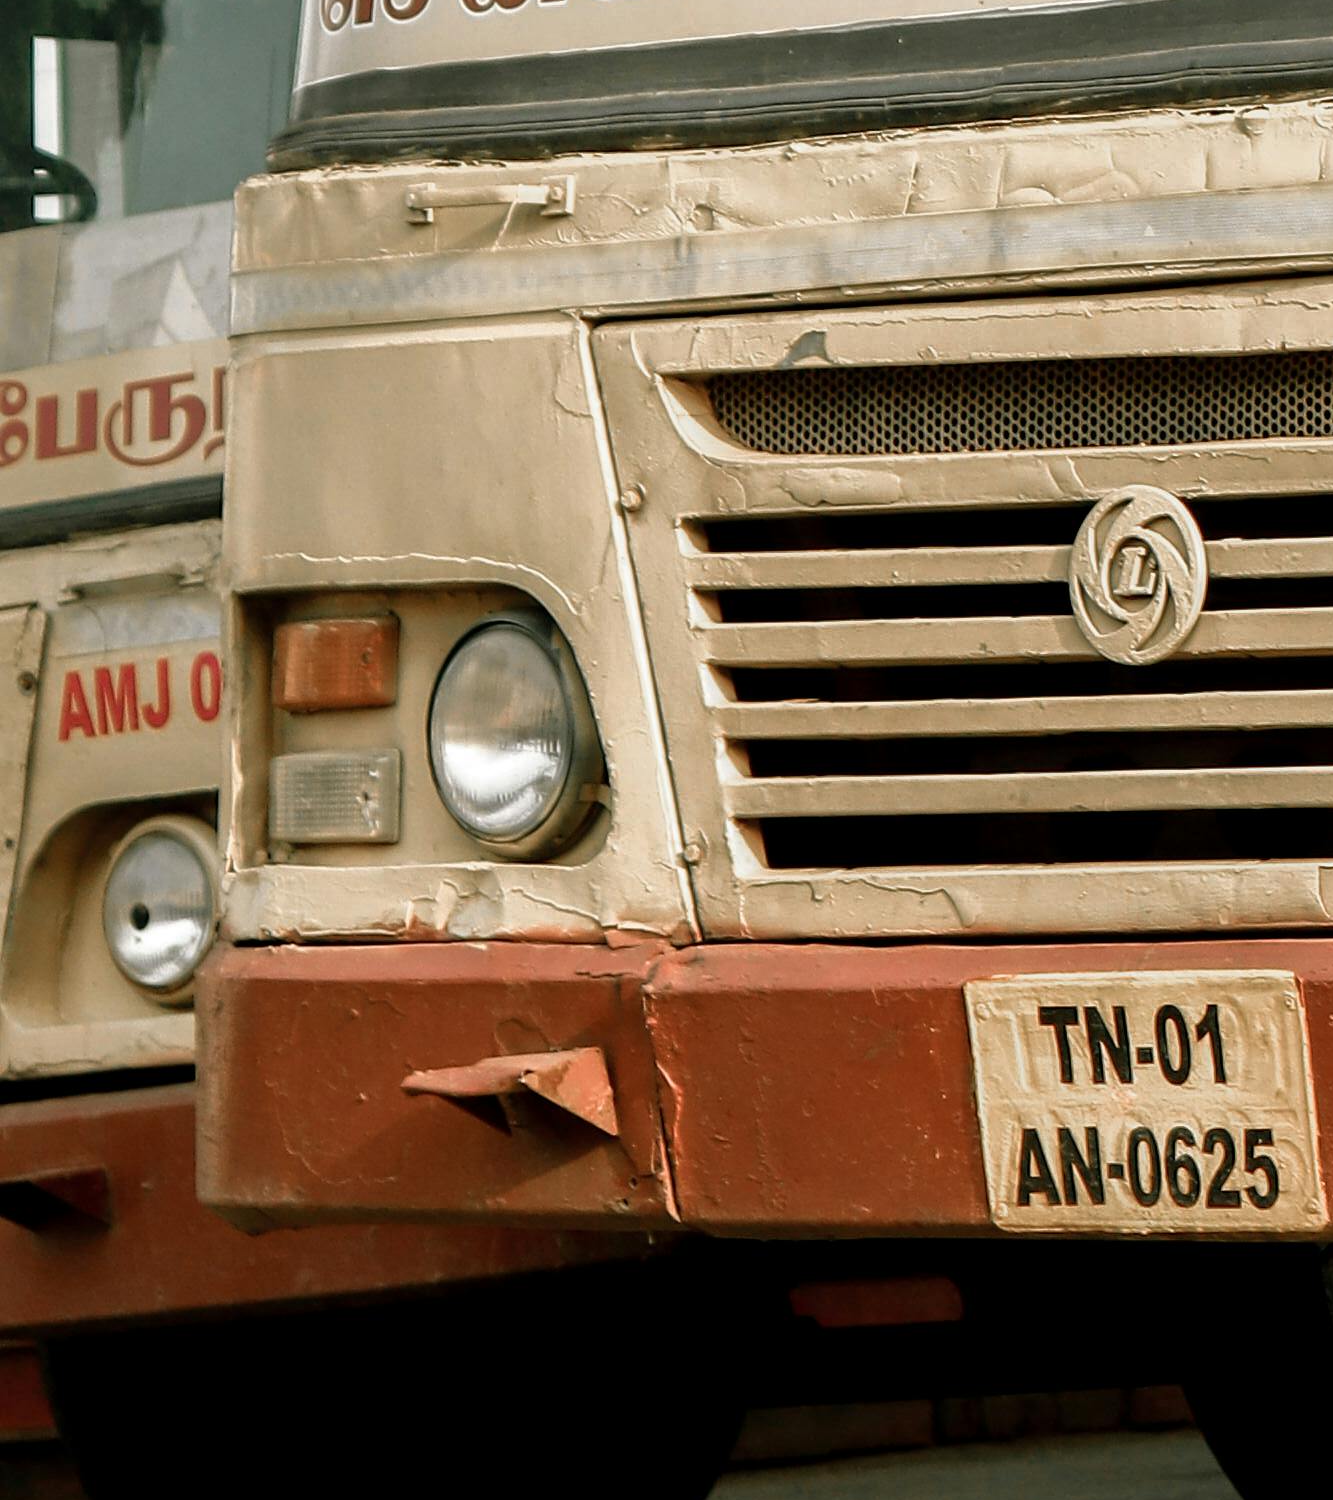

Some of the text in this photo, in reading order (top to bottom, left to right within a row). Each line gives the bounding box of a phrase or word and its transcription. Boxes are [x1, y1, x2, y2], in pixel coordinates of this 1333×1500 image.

[0, 367, 225, 467] பேரு
[58, 657, 170, 741] AMJ
[1039, 1003, 1227, 1086] TN-01
[1016, 1124, 1281, 1211] AN-0625
